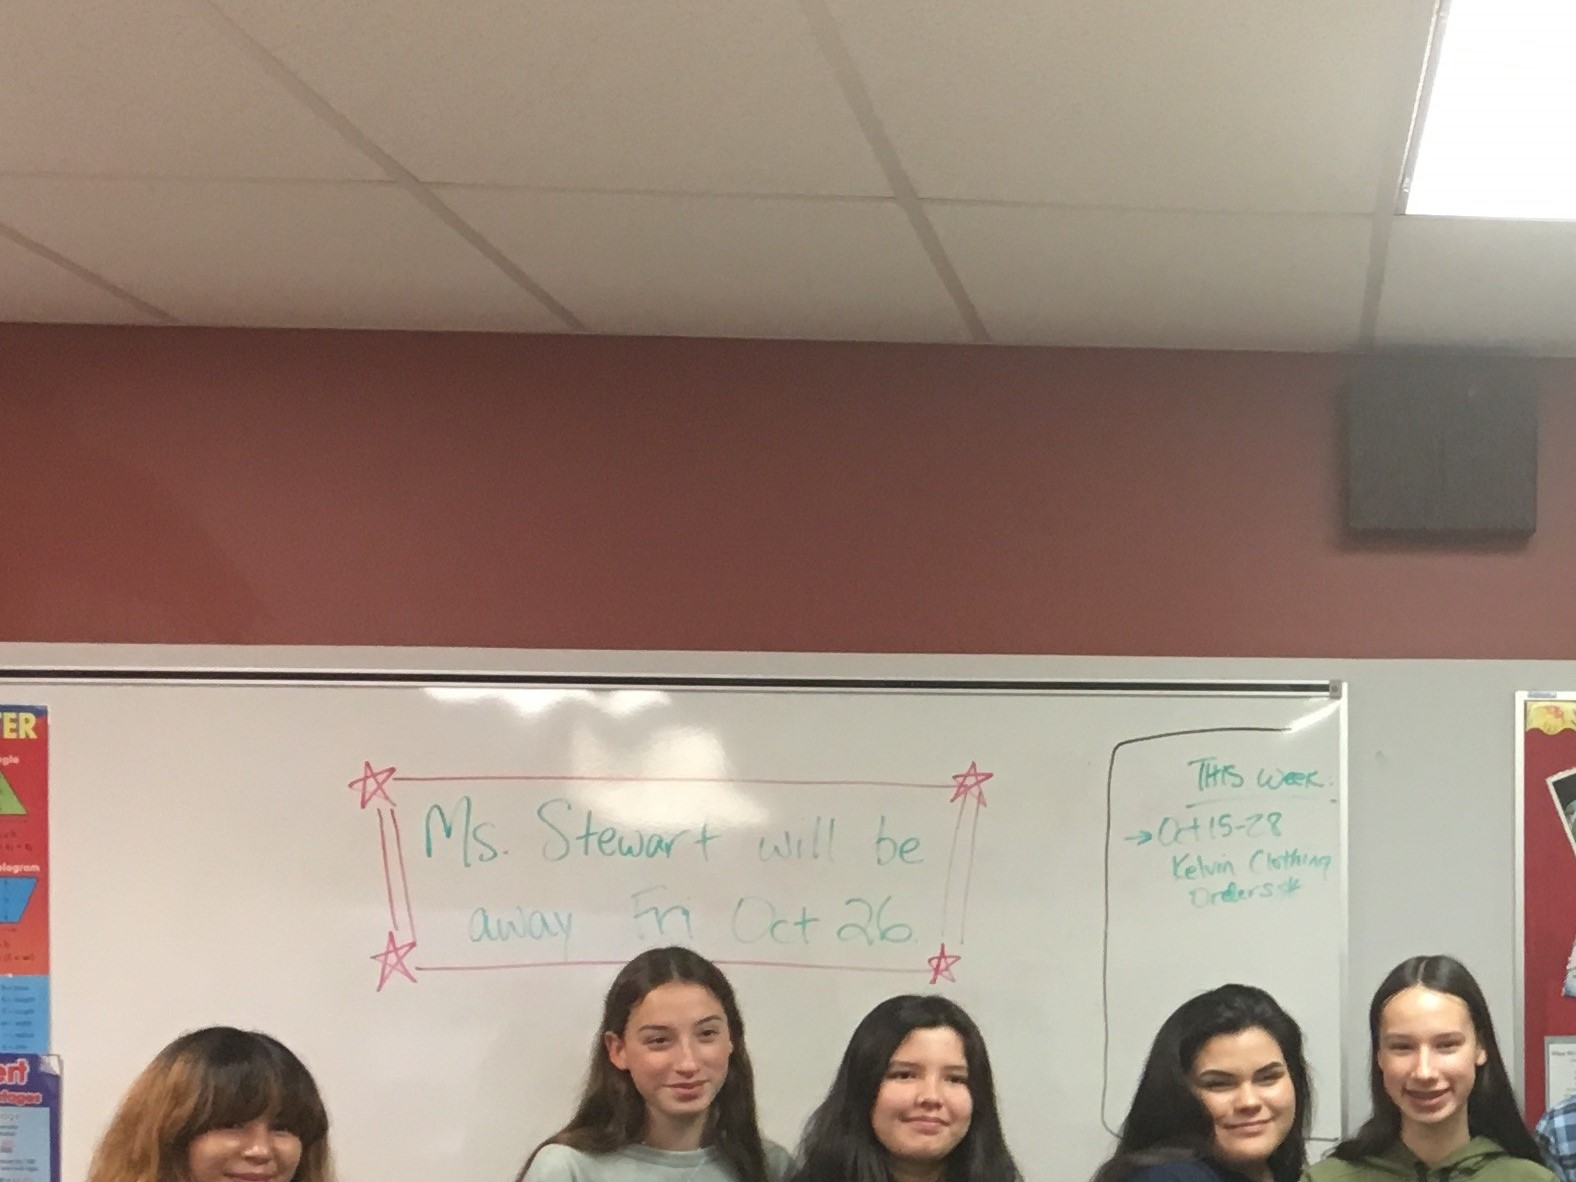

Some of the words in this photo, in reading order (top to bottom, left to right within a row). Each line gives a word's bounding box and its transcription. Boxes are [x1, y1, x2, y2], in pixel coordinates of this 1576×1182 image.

[0, 712, 38, 739] ER
[424, 796, 509, 867] Ms.
[537, 798, 714, 863] Stewart
[758, 812, 836, 865] will
[876, 815, 925, 865] be
[467, 905, 573, 960] away
[731, 896, 820, 945] Oct
